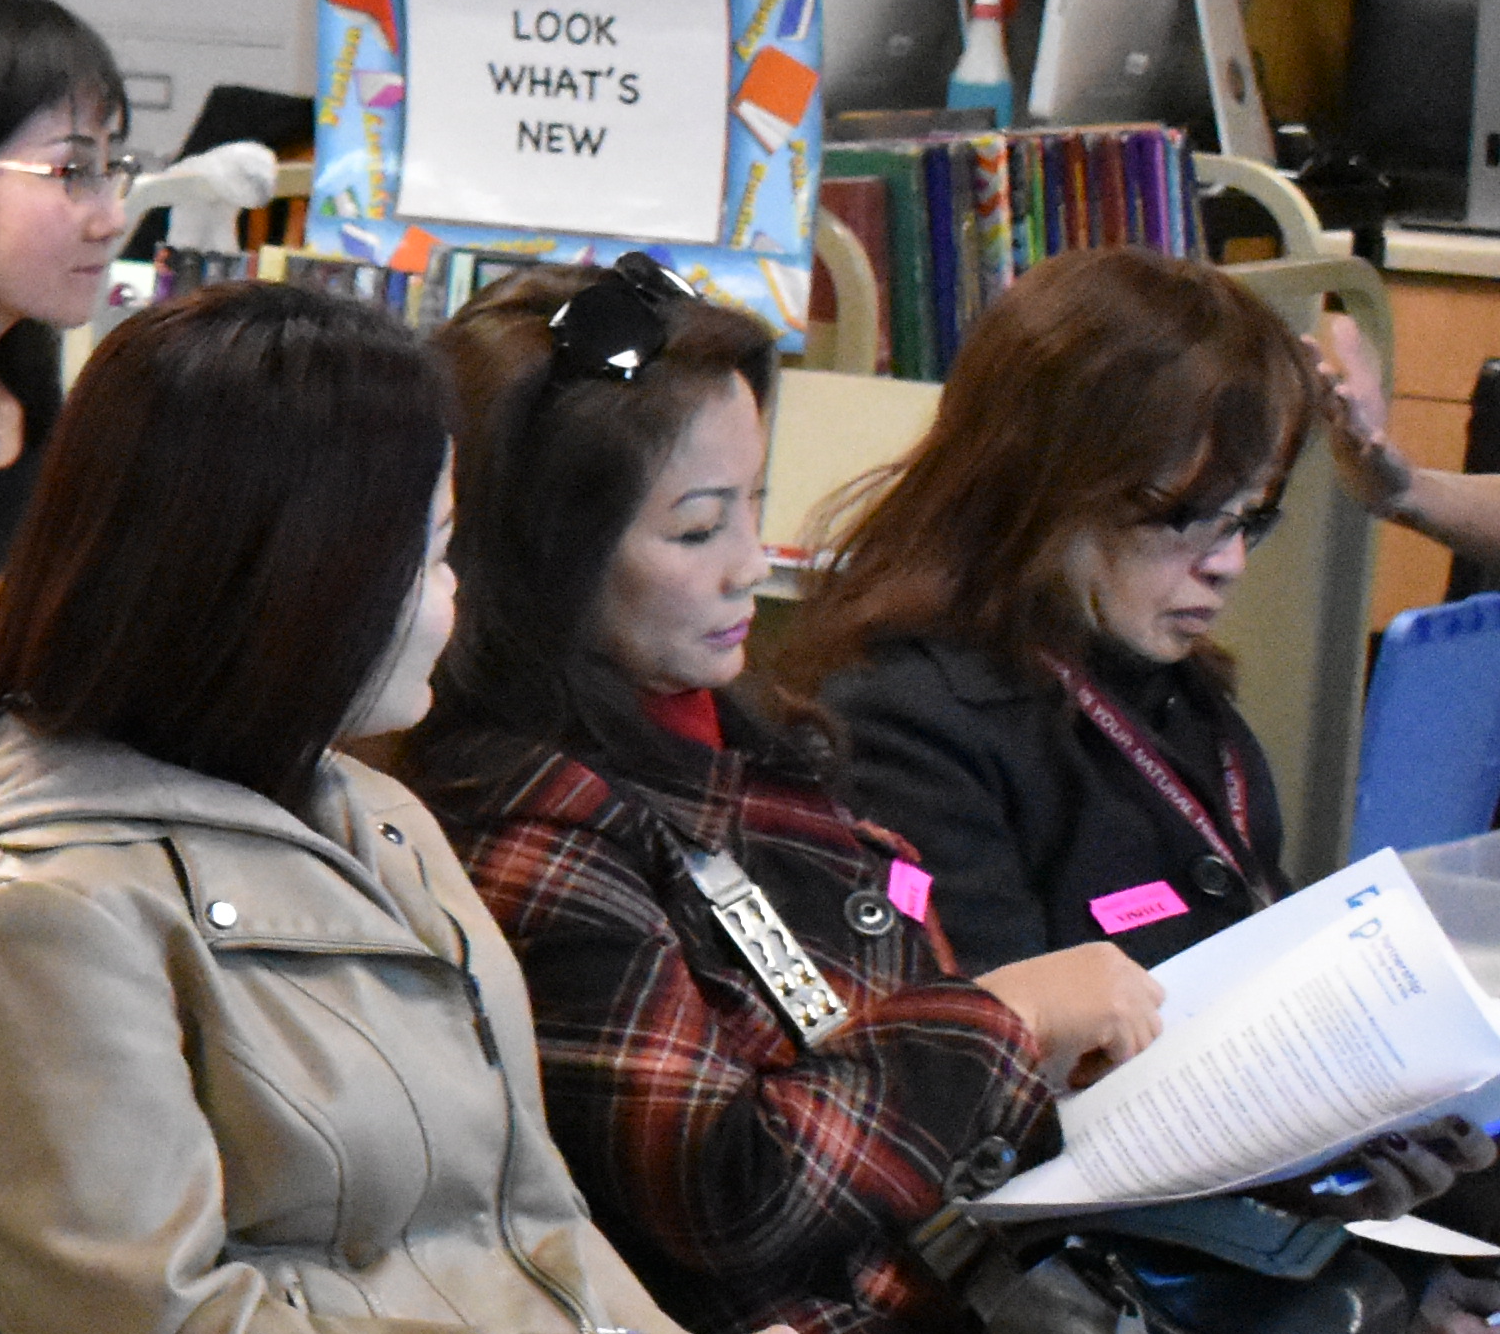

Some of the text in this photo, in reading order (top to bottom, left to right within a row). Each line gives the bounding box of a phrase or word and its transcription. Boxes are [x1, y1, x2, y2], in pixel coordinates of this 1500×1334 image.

[512, 9, 618, 46] LOOK
[486, 60, 641, 105] WHAT'S
[516, 119, 607, 157] NEW
[1092, 703, 1136, 750] YOUR
[1133, 746, 1194, 819] NATURAL
